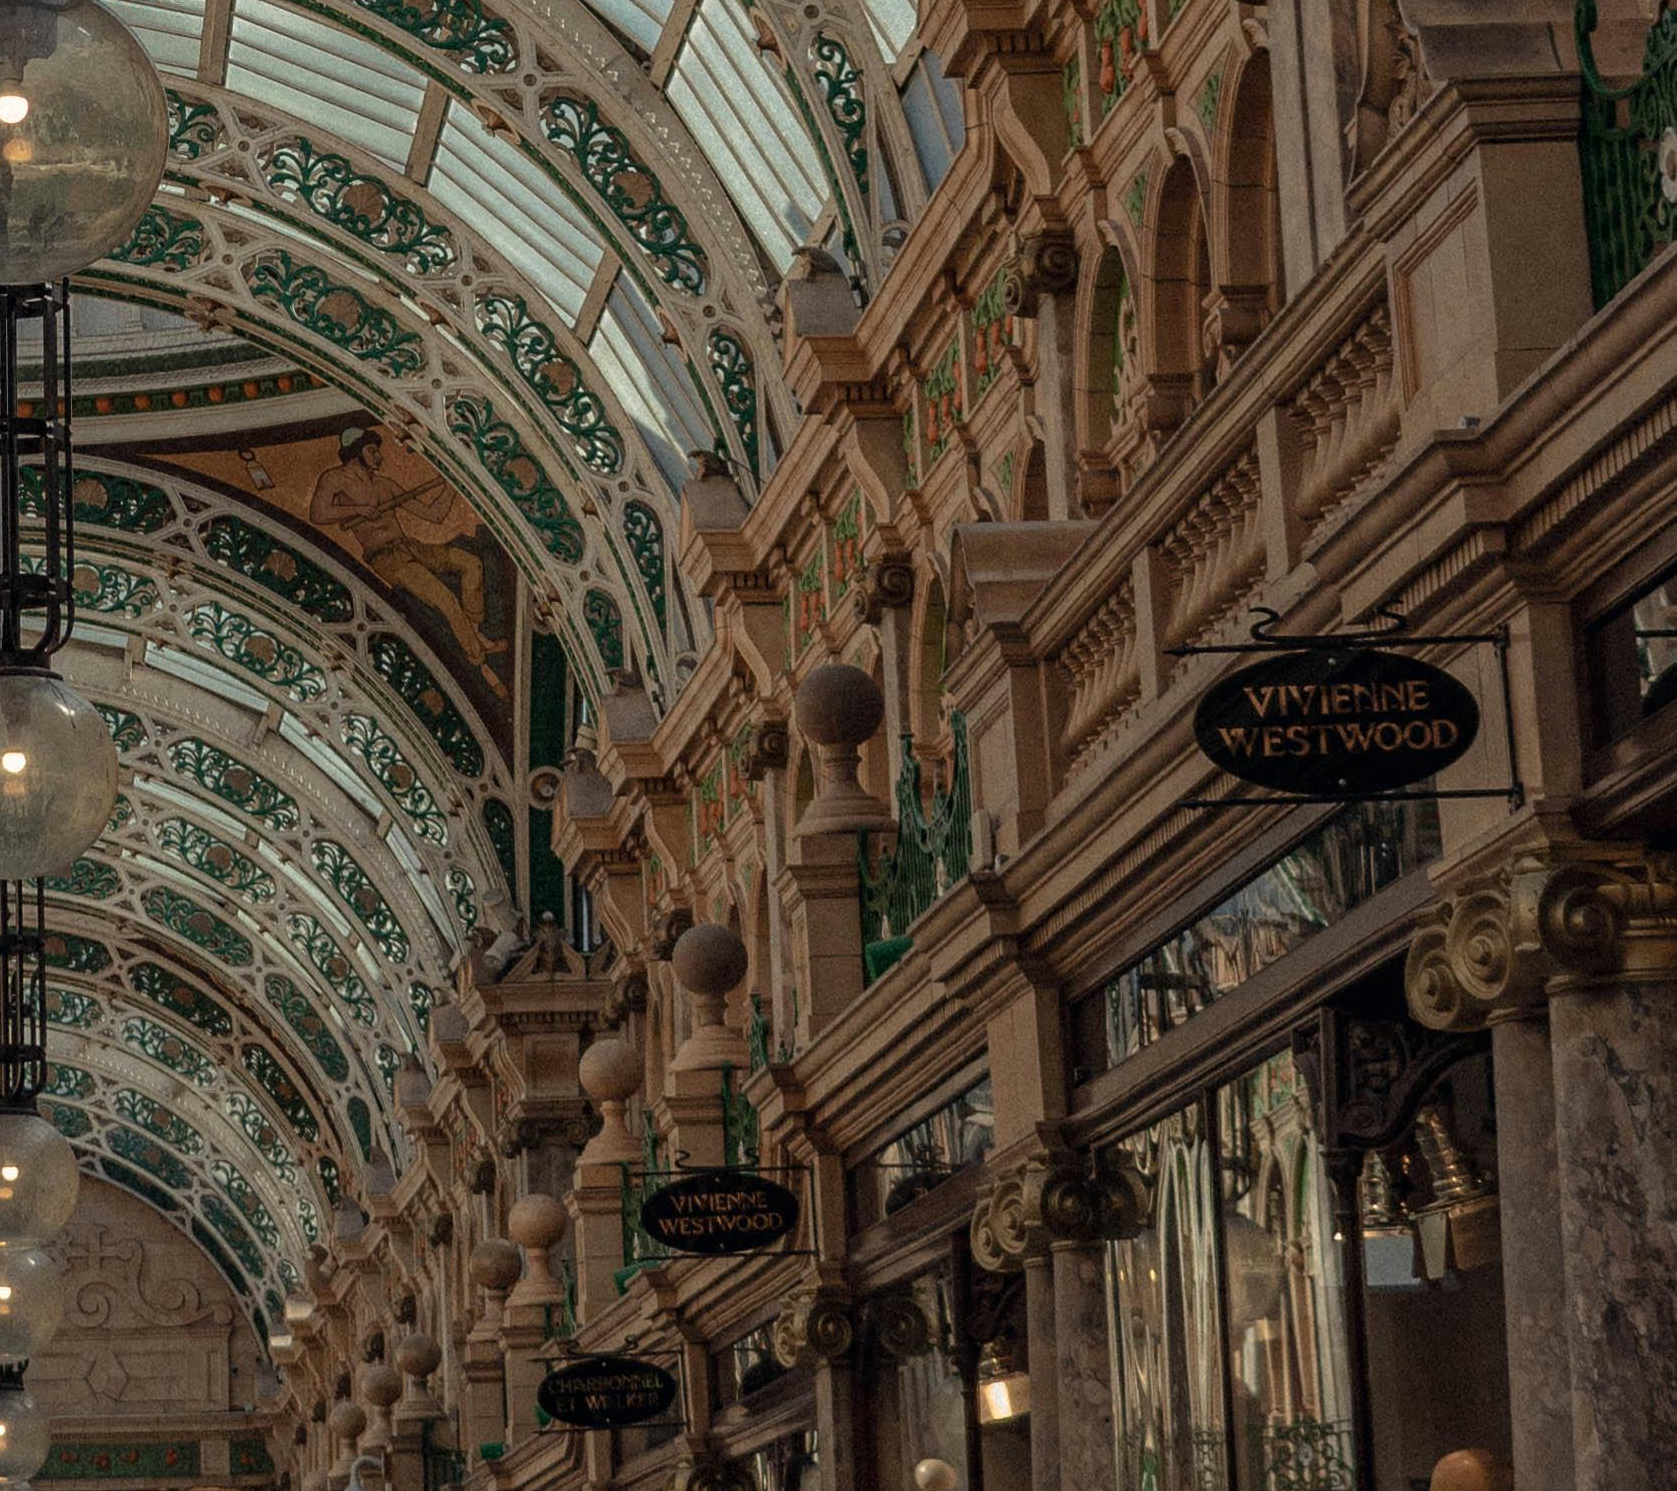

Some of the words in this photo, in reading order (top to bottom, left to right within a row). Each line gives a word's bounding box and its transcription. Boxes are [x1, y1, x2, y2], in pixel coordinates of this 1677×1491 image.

[1242, 678, 1431, 718] VIVIENNE
[1218, 717, 1460, 758] WESTWOOD
[667, 1189, 768, 1214] VIVIENNE
[657, 1212, 784, 1237] WESTWOOD
